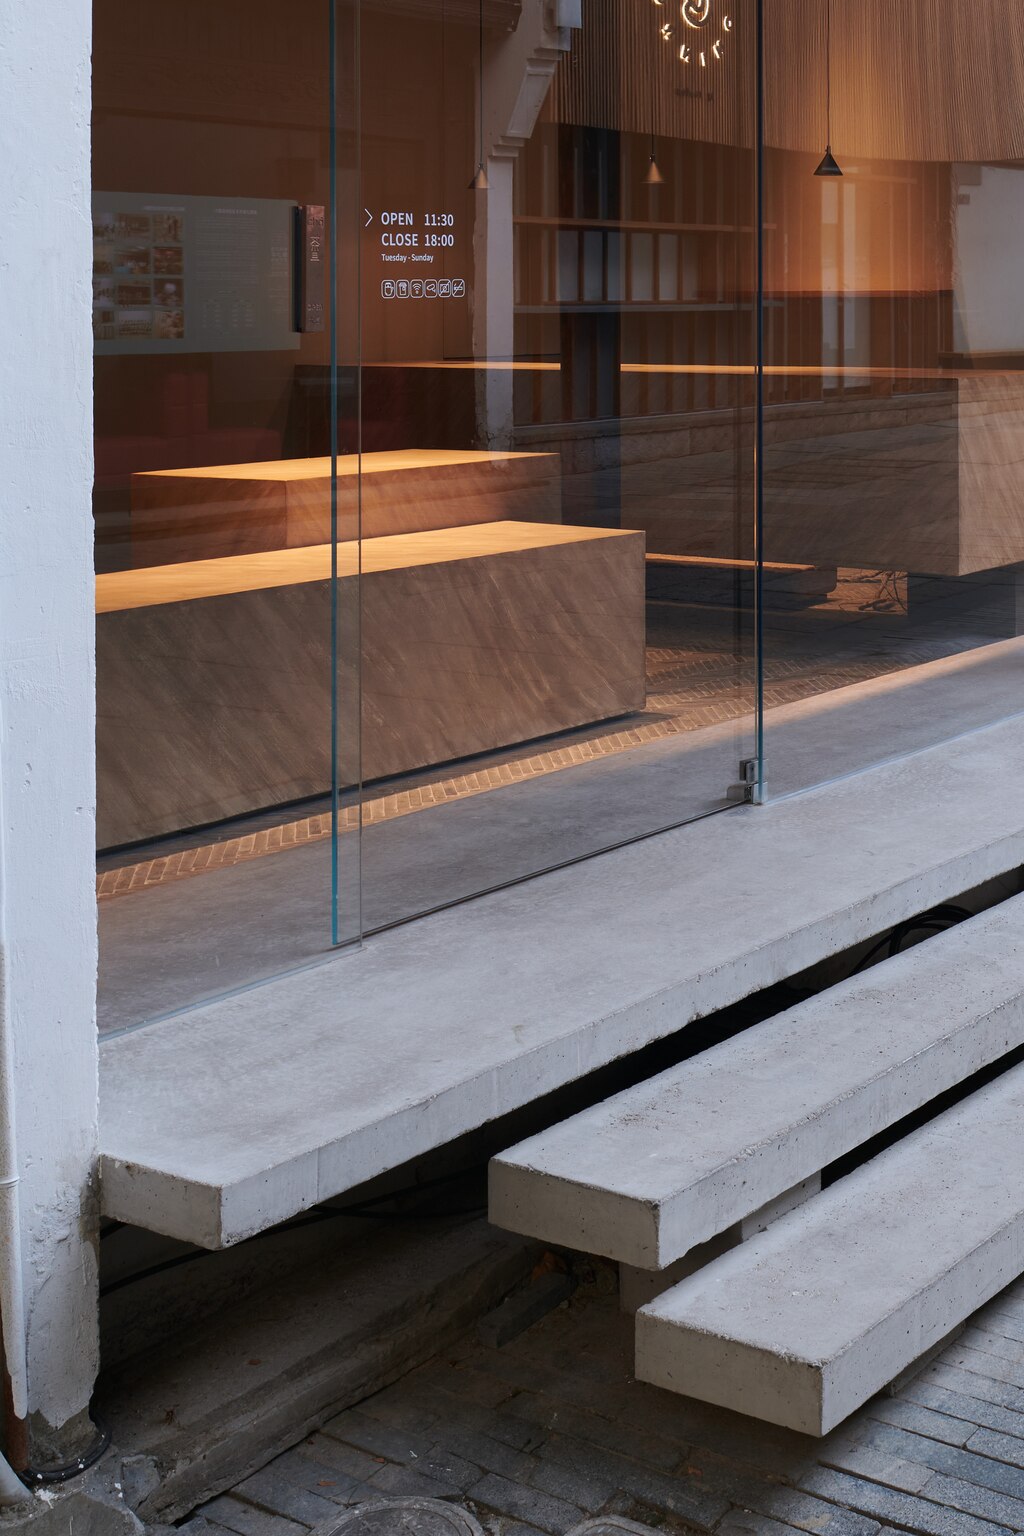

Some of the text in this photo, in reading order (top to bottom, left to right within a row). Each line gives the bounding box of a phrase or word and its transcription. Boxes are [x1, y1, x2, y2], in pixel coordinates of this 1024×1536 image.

[381, 212, 454, 226] OPEN 11:30
[381, 233, 454, 247] CLOSE 18:00
[381, 253, 407, 263] Tuesday
[411, 253, 434, 263] Sunday
